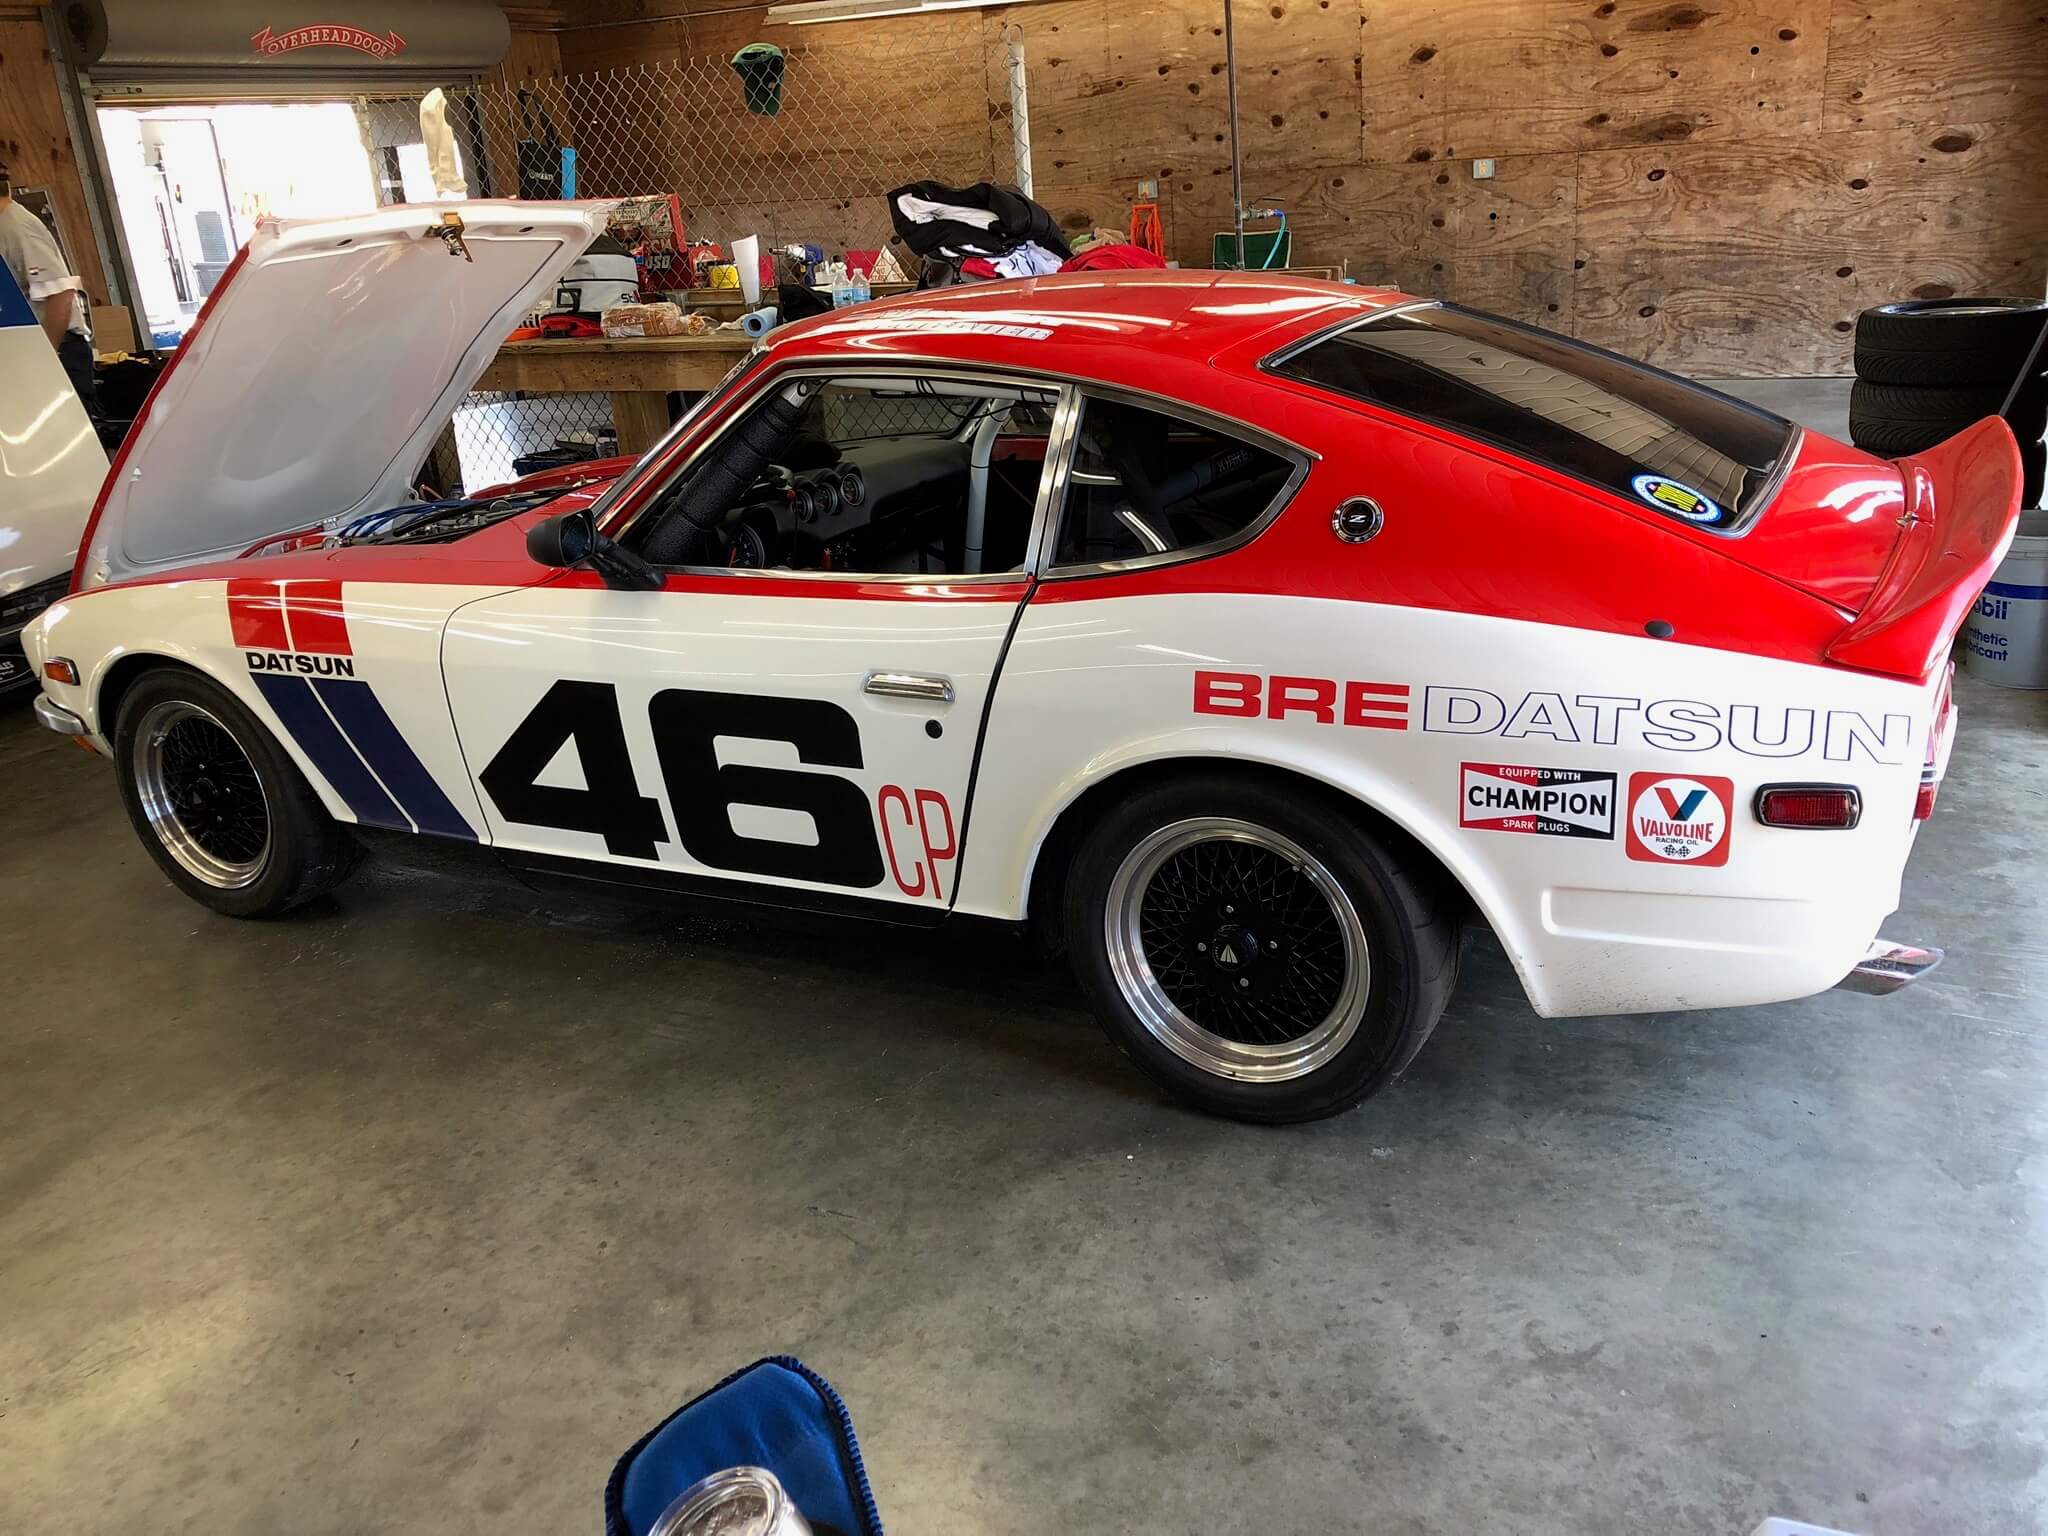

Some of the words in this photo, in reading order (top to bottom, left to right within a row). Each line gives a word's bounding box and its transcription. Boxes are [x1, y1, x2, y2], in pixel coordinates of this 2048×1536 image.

[268, 28, 350, 54] OVERHEAD
[353, 34, 389, 57] DOOR
[1974, 596, 2008, 620] obil
[245, 651, 355, 677] DATSUN
[1193, 670, 1411, 731] BRE
[1422, 684, 1912, 766] DATSUN
[1499, 767, 1551, 779] EQUIPPED
[1553, 771, 1582, 782] WITH
[478, 679, 887, 889] 46
[878, 784, 957, 900] CP
[1468, 785, 1608, 817] CHAMPION
[1503, 819, 1535, 830] SPARK
[1537, 821, 1571, 833] PLUGS
[1640, 816, 1715, 843] VALVOLINE
[1655, 836, 1684, 845] RACING
